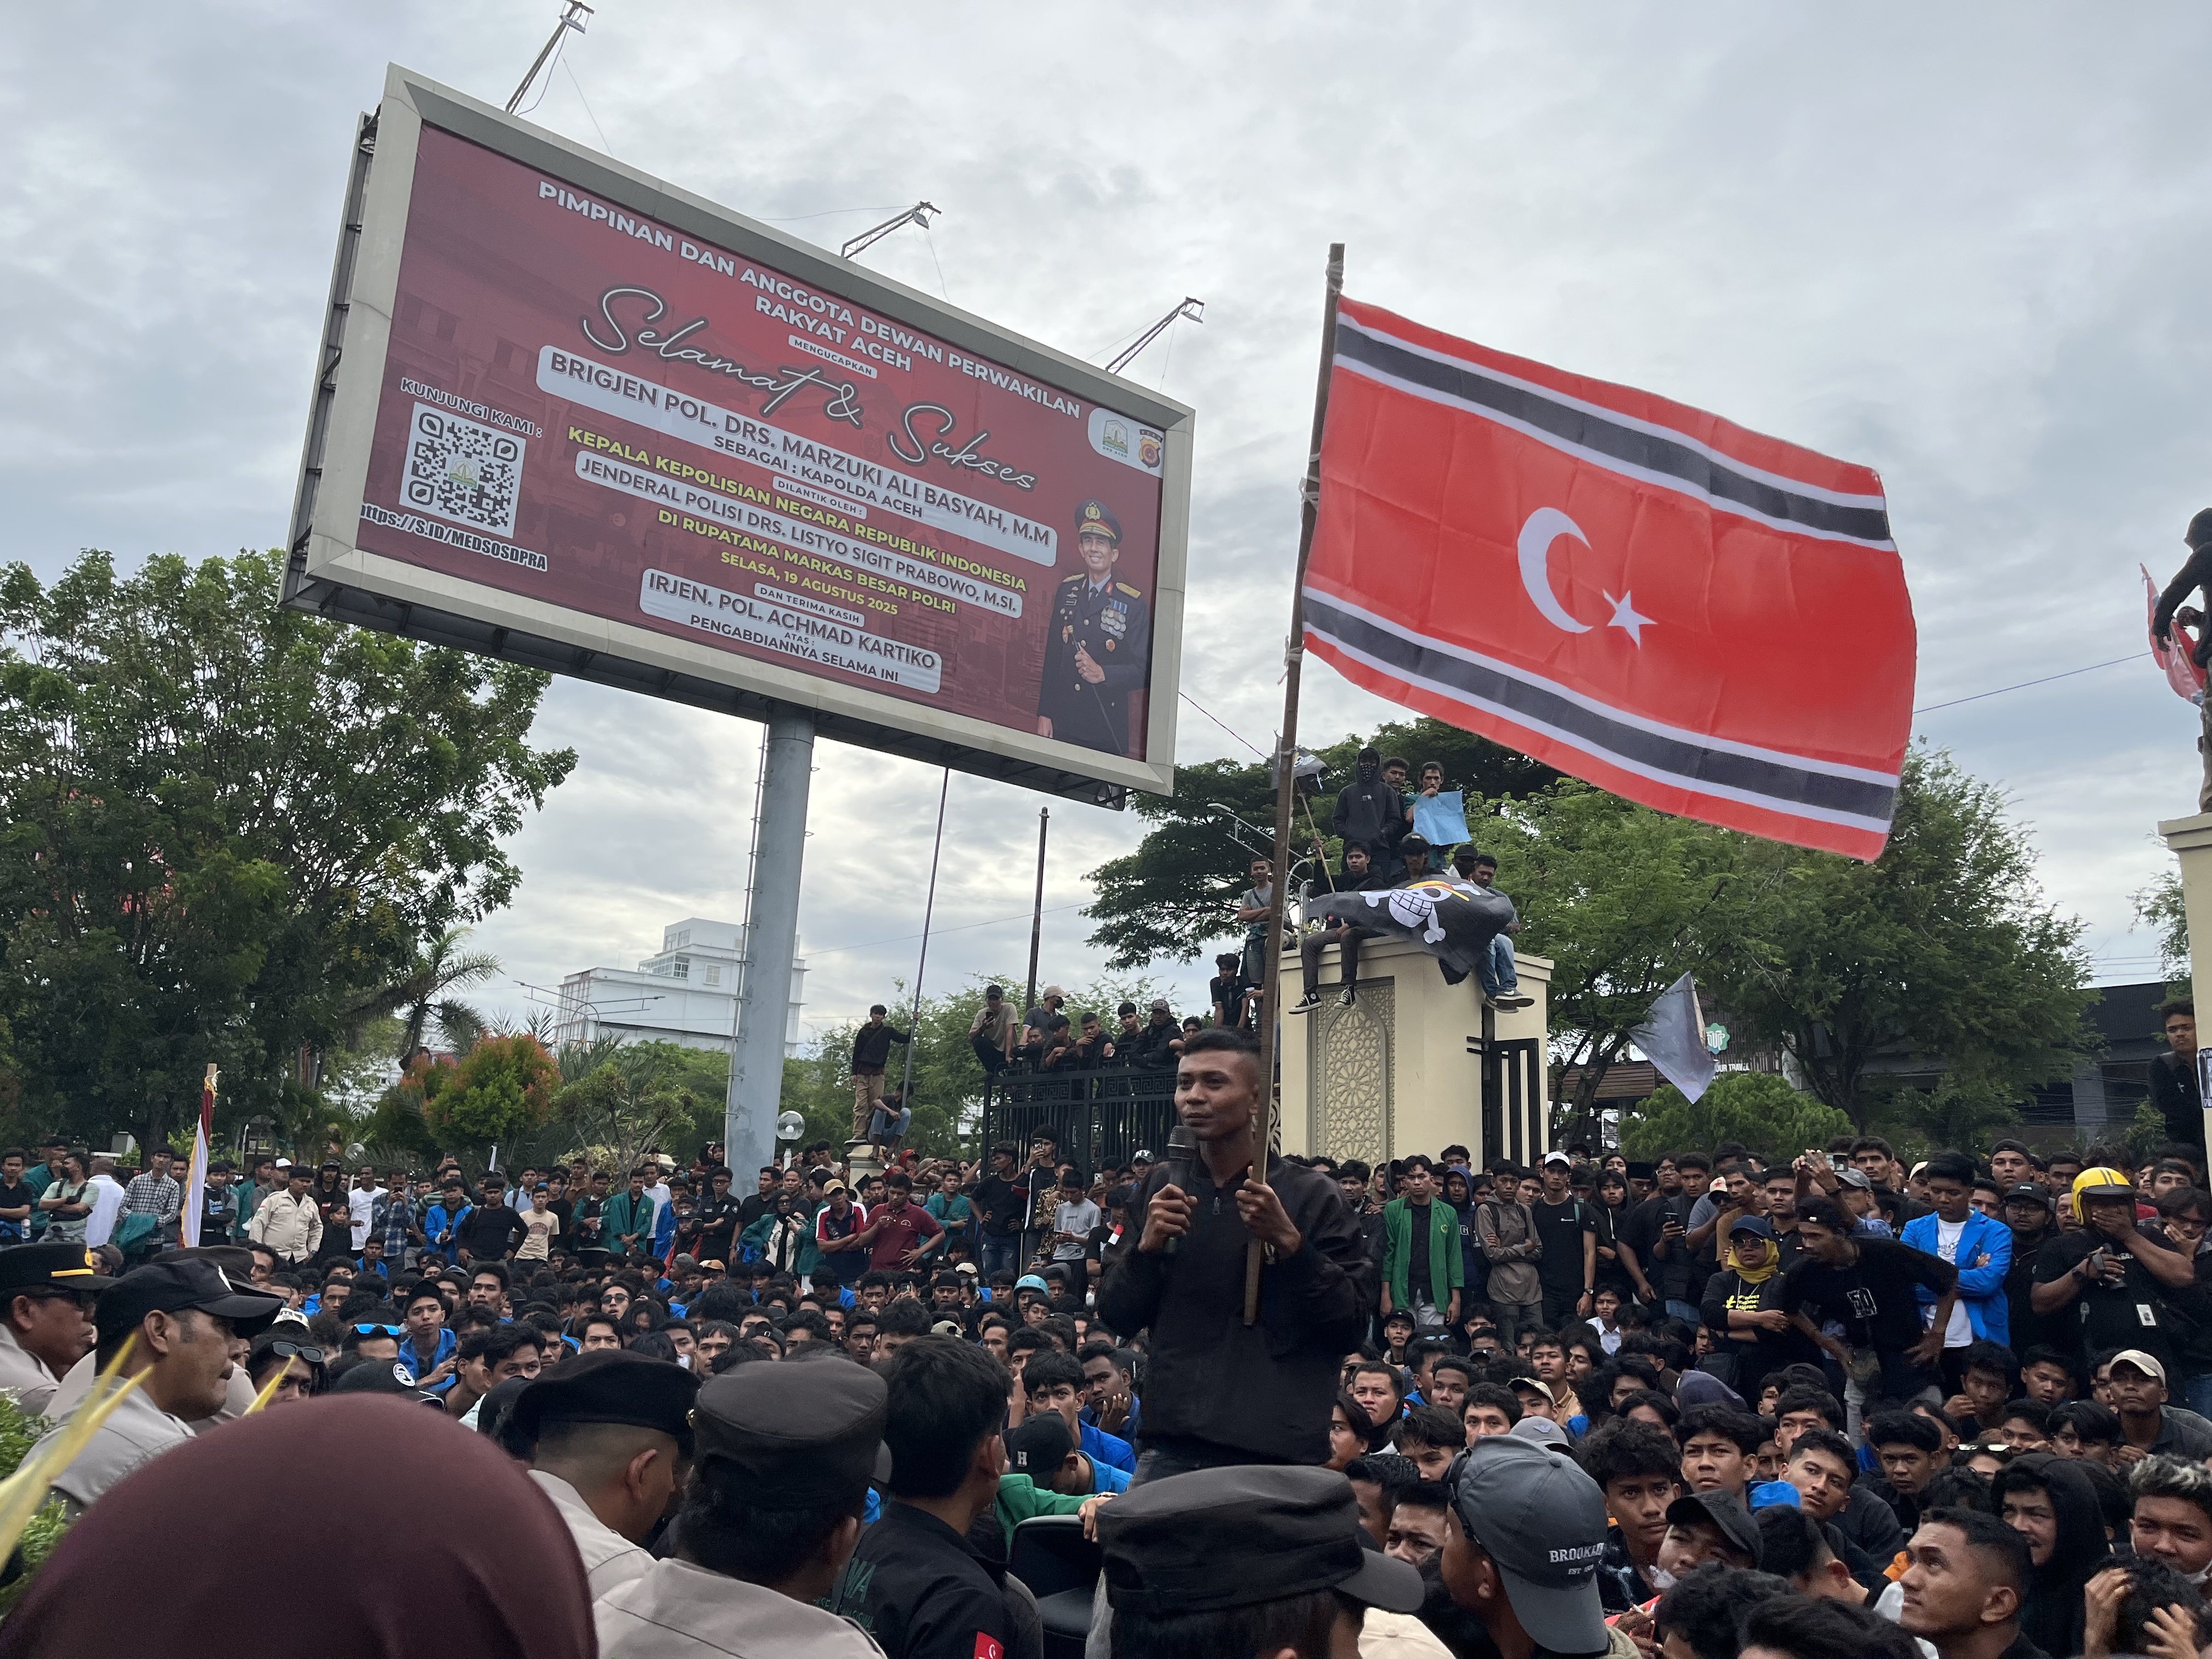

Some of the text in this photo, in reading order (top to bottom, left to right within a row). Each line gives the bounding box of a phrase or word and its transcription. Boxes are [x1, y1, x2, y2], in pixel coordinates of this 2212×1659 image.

[539, 181, 1080, 419] PIMPINAN DAN ANGGOTA DEWAN PERWAKILAN
[755, 295, 911, 372] RAKYAT ACEH
[583, 288, 1036, 489] Selamat & Sukses
[793, 338, 872, 375] MENGUCAPKAN
[402, 378, 488, 419] KUNJUNGI
[493, 410, 533, 435] KAMI
[551, 352, 1050, 547] BRIGJEN POL. DRS. MARZUKI ALI BASYAH, M.M
[714, 435, 788, 471] SEBAGAI
[801, 466, 877, 502] KAPOLDA
[882, 496, 923, 518] ACEH
[568, 426, 1027, 591] KEPALA KEPOLISIAN NEGARA REPUBLIK INDONESIA
[582, 458, 1017, 613] JENDERAL POLISI DRS. LISTYO SIGIT PRABOWO, M.SI.
[778, 481, 827, 503] DILANTIK
[830, 499, 857, 514] OLEH
[658, 509, 956, 614] DI RUPATAMA MARKAS BESAR POLRI
[720, 551, 898, 615] SELASA, 19 AGUSTUS 2025
[649, 573, 935, 670] IRJEN. POL. ACHMAD KARTIKO
[760, 587, 860, 624] DAN TERIMA KASIH
[785, 632, 810, 645] ATAS
[690, 615, 899, 682] PENGABDIANNYA SELAMA INI
[1017, 1451, 1028, 1467] H
